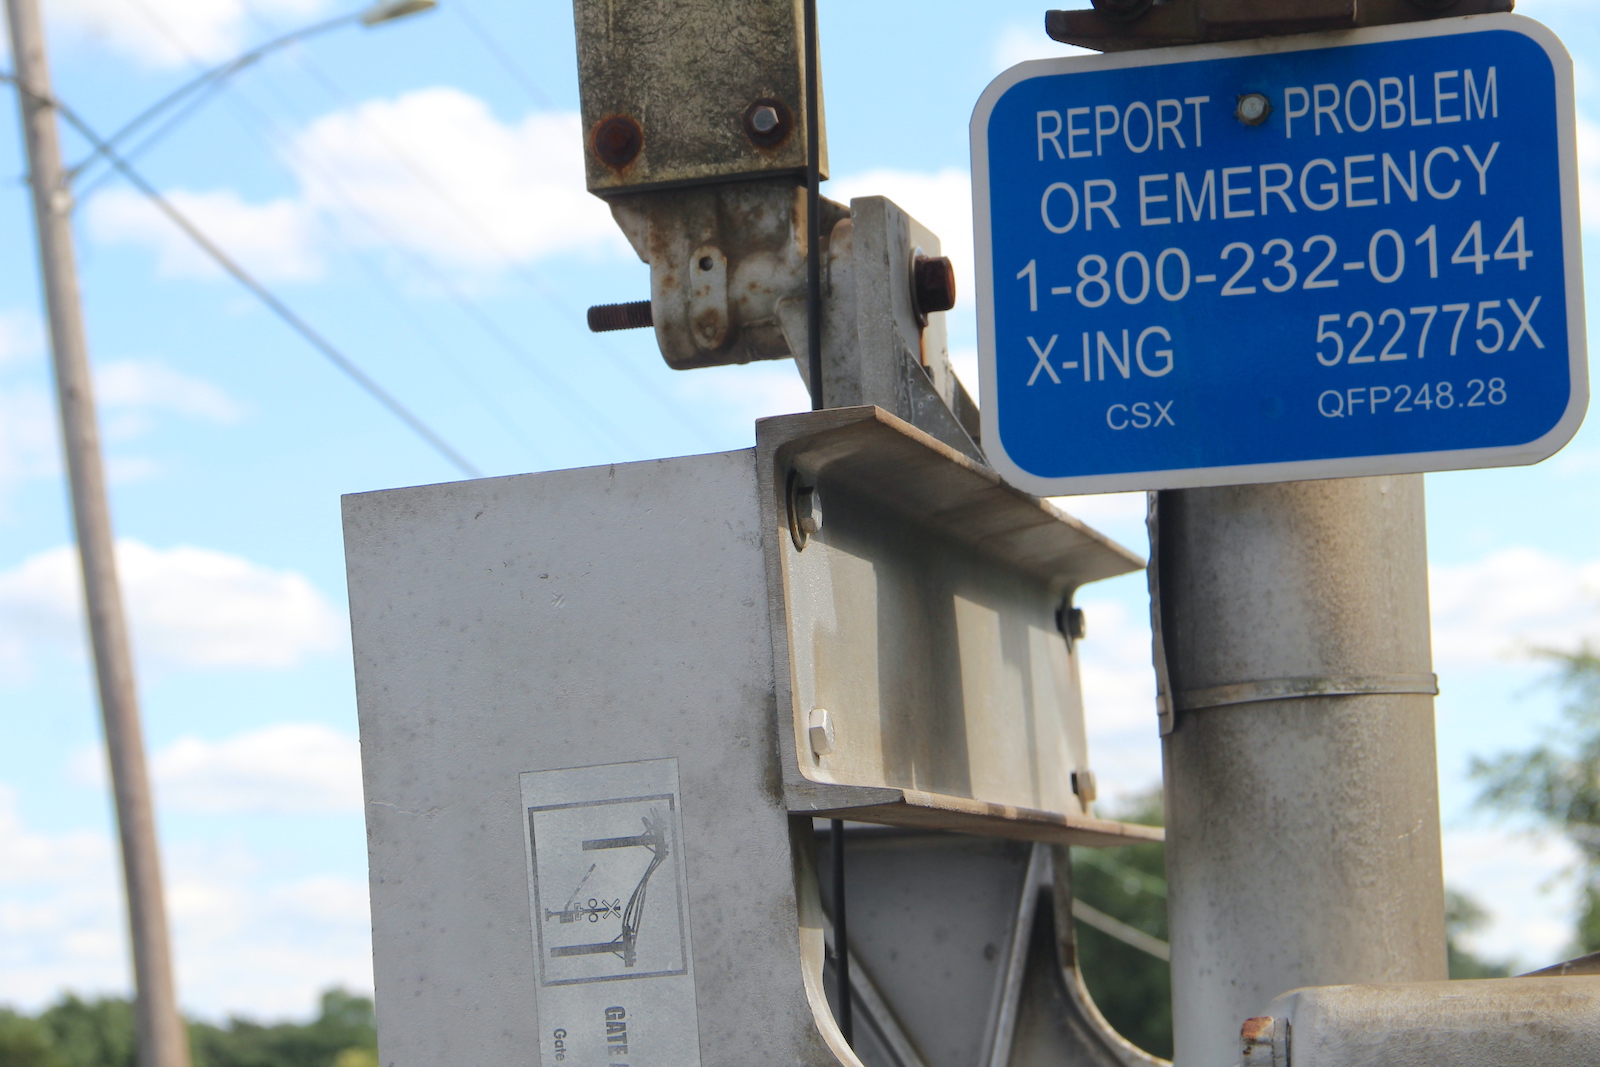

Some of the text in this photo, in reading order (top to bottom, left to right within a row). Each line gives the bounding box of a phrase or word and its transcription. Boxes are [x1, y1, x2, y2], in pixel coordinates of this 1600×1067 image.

[1036, 66, 1499, 161] REPORT PROBLEM
[1040, 141, 1500, 235] OR EMERGENCY
[1015, 216, 1533, 312] 1-800-232-0144
[1026, 295, 1545, 387] X-ING 522775X
[1105, 377, 1507, 431] CSX QFP248.28
[553, 1028, 567, 1062] Gate
[604, 1006, 629, 1056] GATE
